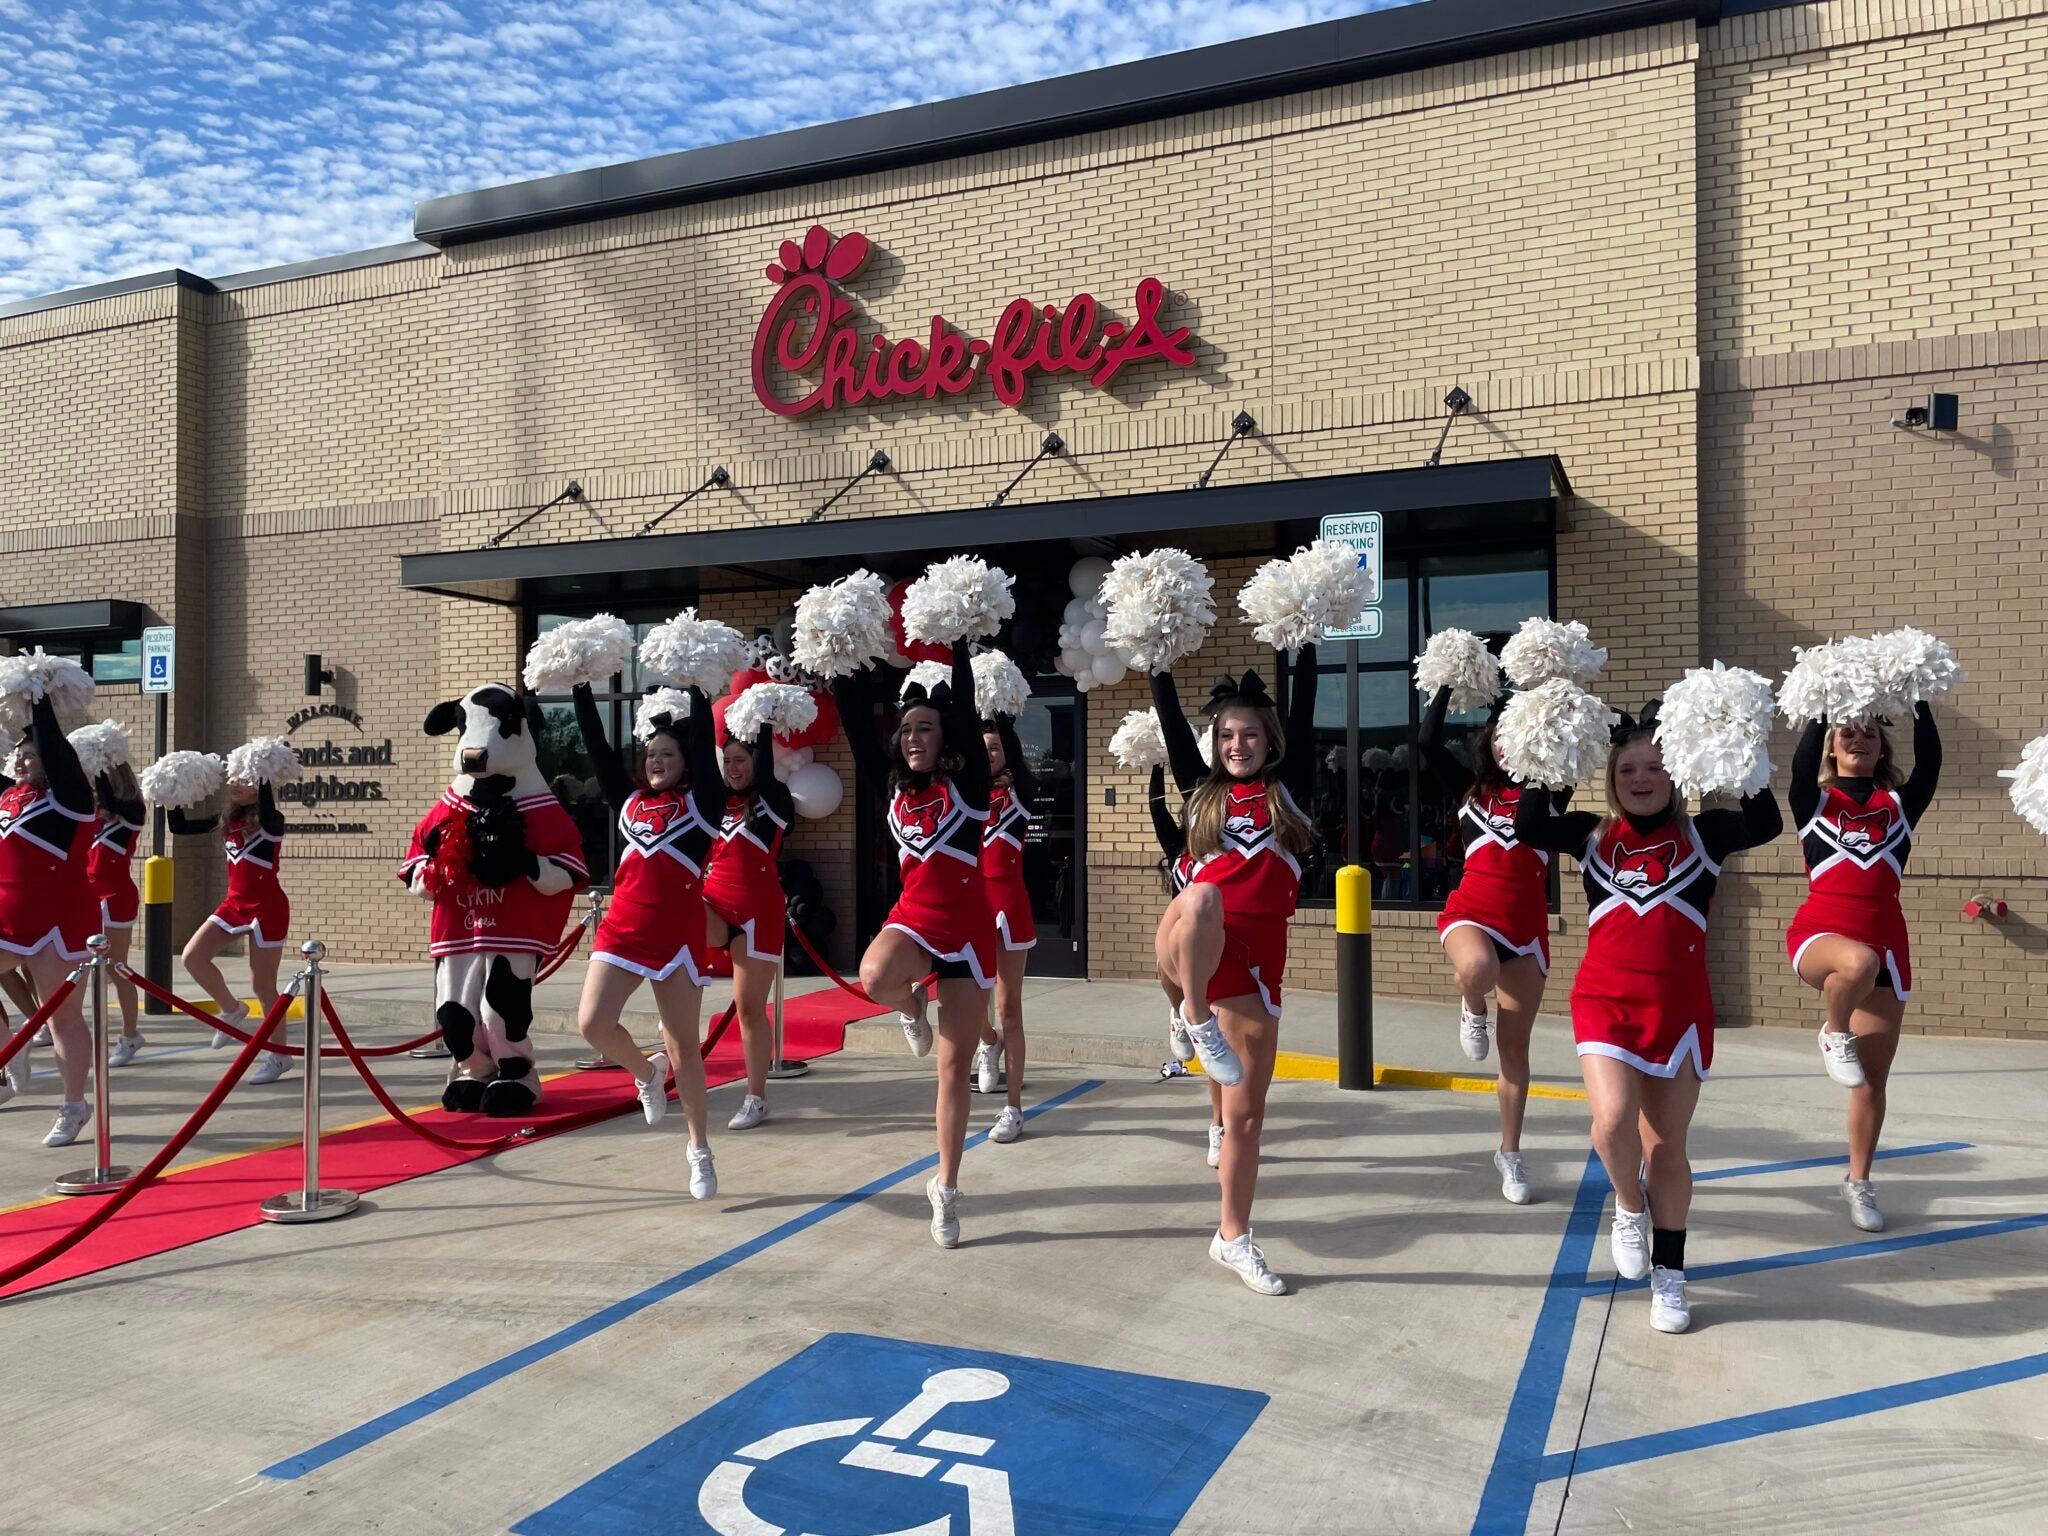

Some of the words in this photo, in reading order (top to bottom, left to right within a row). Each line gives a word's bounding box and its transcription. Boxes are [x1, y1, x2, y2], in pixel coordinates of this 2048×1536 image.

[752, 225, 1196, 416] Chick-fil-A
[1326, 522, 1378, 536] RESERVED
[146, 633, 173, 643] RESERVED
[147, 645, 171, 654] PARKING
[286, 704, 364, 730] WELCOME
[284, 739, 345, 765] ends
[348, 738, 393, 765] and
